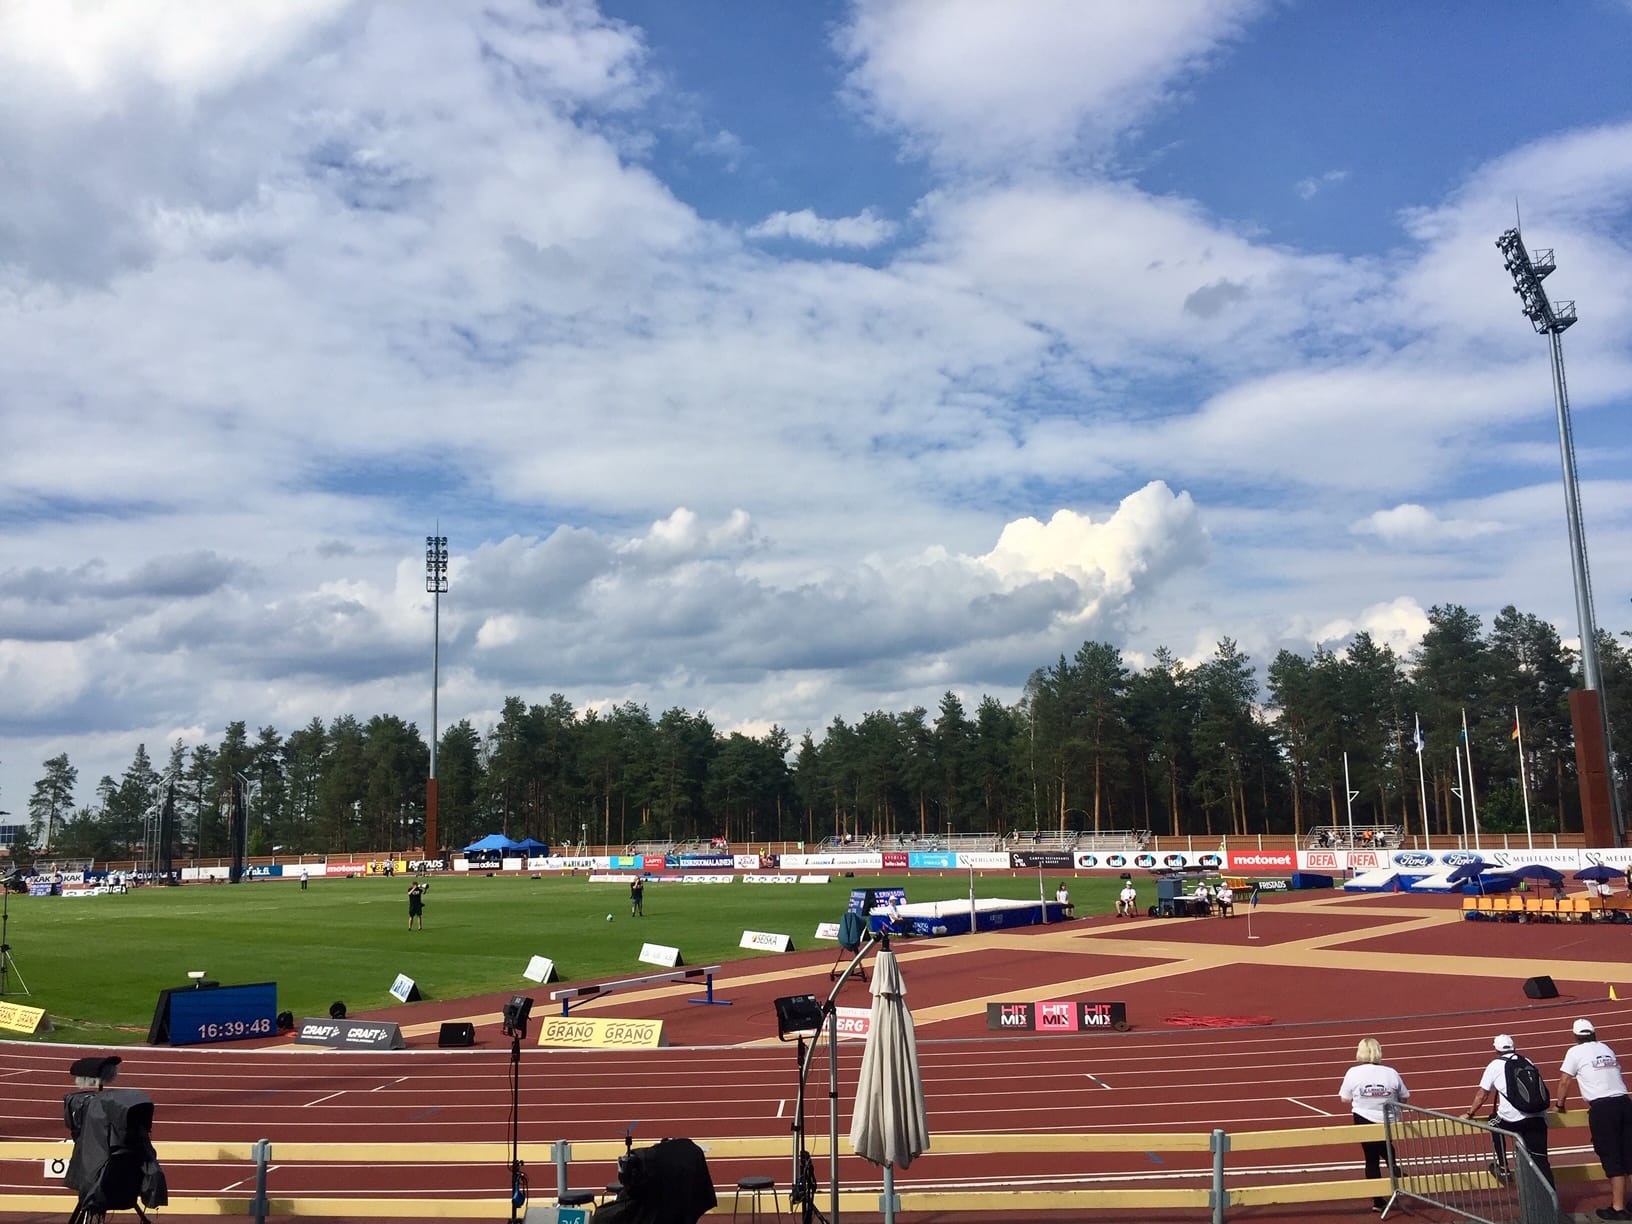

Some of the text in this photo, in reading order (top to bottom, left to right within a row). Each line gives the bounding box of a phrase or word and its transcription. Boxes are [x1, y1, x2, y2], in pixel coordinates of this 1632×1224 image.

[1233, 855, 1291, 865] motonet
[1309, 855, 1375, 865] DEFA DEFA
[1401, 854, 1475, 866] Ford Ford
[327, 864, 366, 872] motonet
[1001, 1005, 1027, 1014] HIT
[1042, 1005, 1069, 1014] HIT
[1084, 1005, 1111, 1014] HIT
[1001, 1015, 1027, 1025] MIX
[1043, 1015, 1069, 1025] MIX
[1084, 1015, 1111, 1025] MIX
[198, 1018, 271, 1038] 16:39:48
[302, 1025, 380, 1039] CRAFT CRAFT
[547, 1025, 653, 1040] GRANO GRANO
